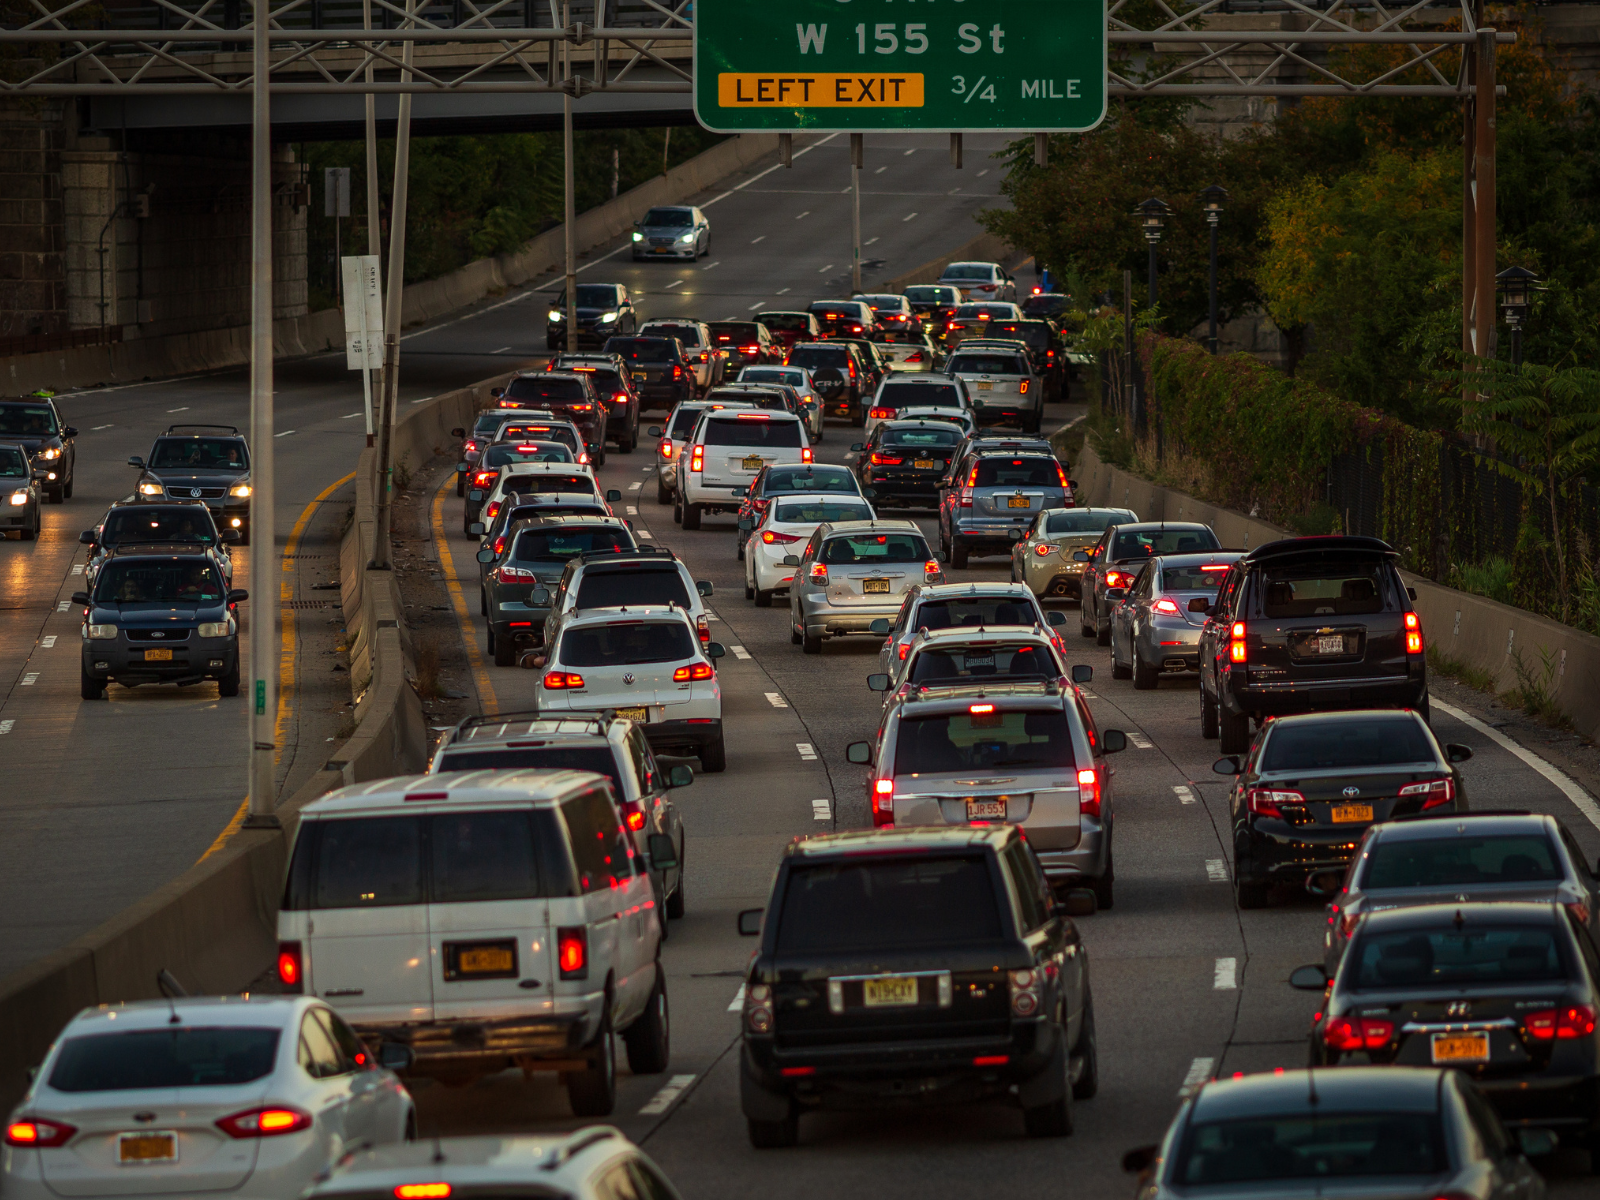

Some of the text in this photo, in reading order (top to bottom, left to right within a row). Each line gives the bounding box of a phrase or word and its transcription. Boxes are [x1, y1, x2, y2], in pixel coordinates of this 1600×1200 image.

[796, 23, 1005, 55] W 155 St
[737, 78, 906, 102] LEFT EXIT
[1021, 79, 1081, 99] MILE
[987, 803, 1004, 814] 553
